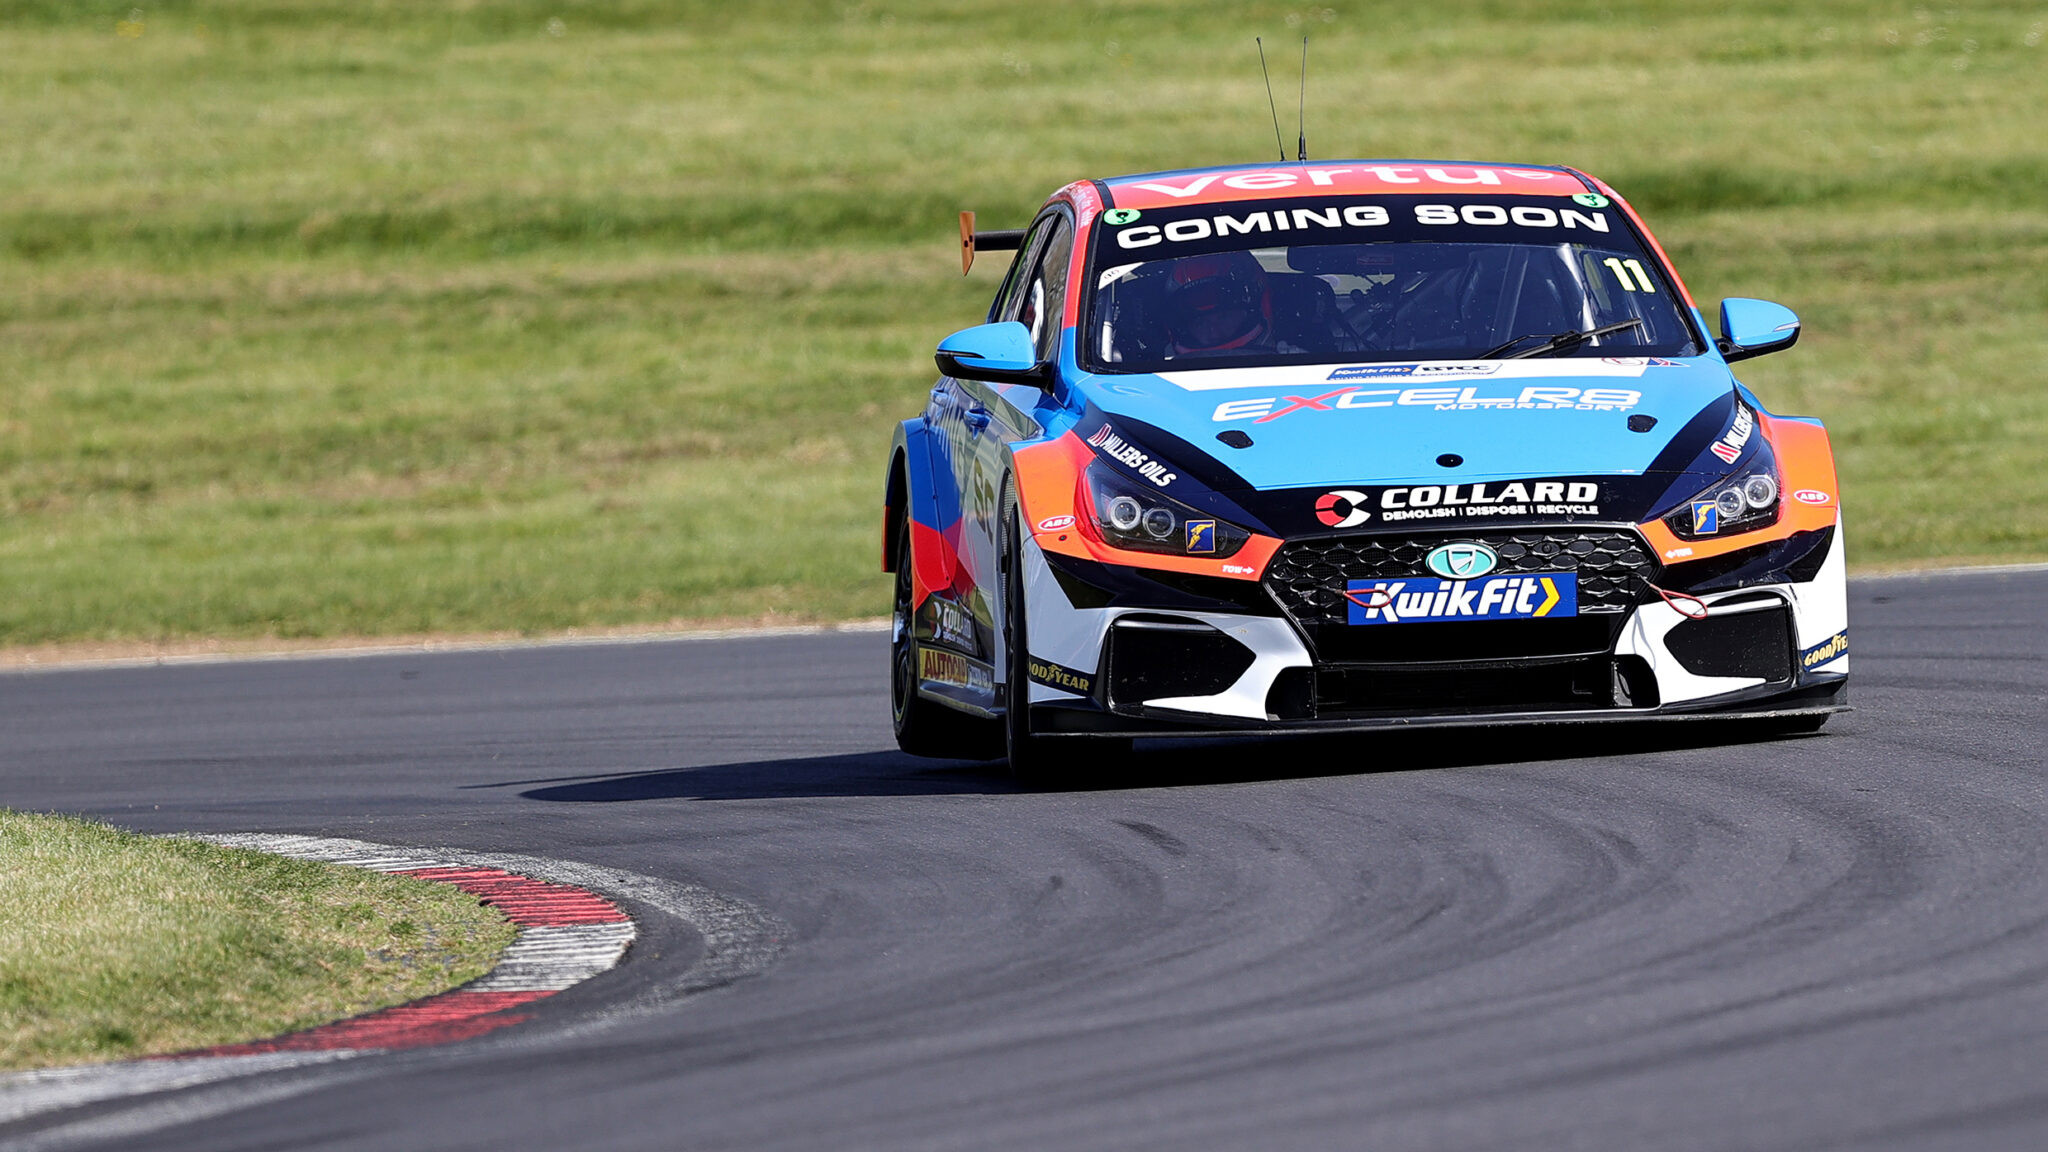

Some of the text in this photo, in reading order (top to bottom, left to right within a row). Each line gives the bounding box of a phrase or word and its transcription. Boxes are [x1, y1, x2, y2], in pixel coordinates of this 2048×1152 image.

[1117, 206, 1390, 249] COMING
[1414, 205, 1610, 232] SOON
[1603, 257, 1656, 293] 11
[1423, 365, 1490, 373] BTCC
[1212, 386, 1642, 423] EXCELR8
[1434, 402, 1634, 412] MOTORSPORT
[1100, 432, 1177, 487] MILLERS OILS
[1380, 482, 1599, 509] COLLARD
[1799, 493, 1825, 501] ABS
[1043, 517, 1072, 528] ABS
[1382, 504, 1599, 521] DEMOLISH DISPOSE RECYCLE
[1222, 564, 1243, 574] TOW
[1029, 661, 1089, 691] ODYEAR
